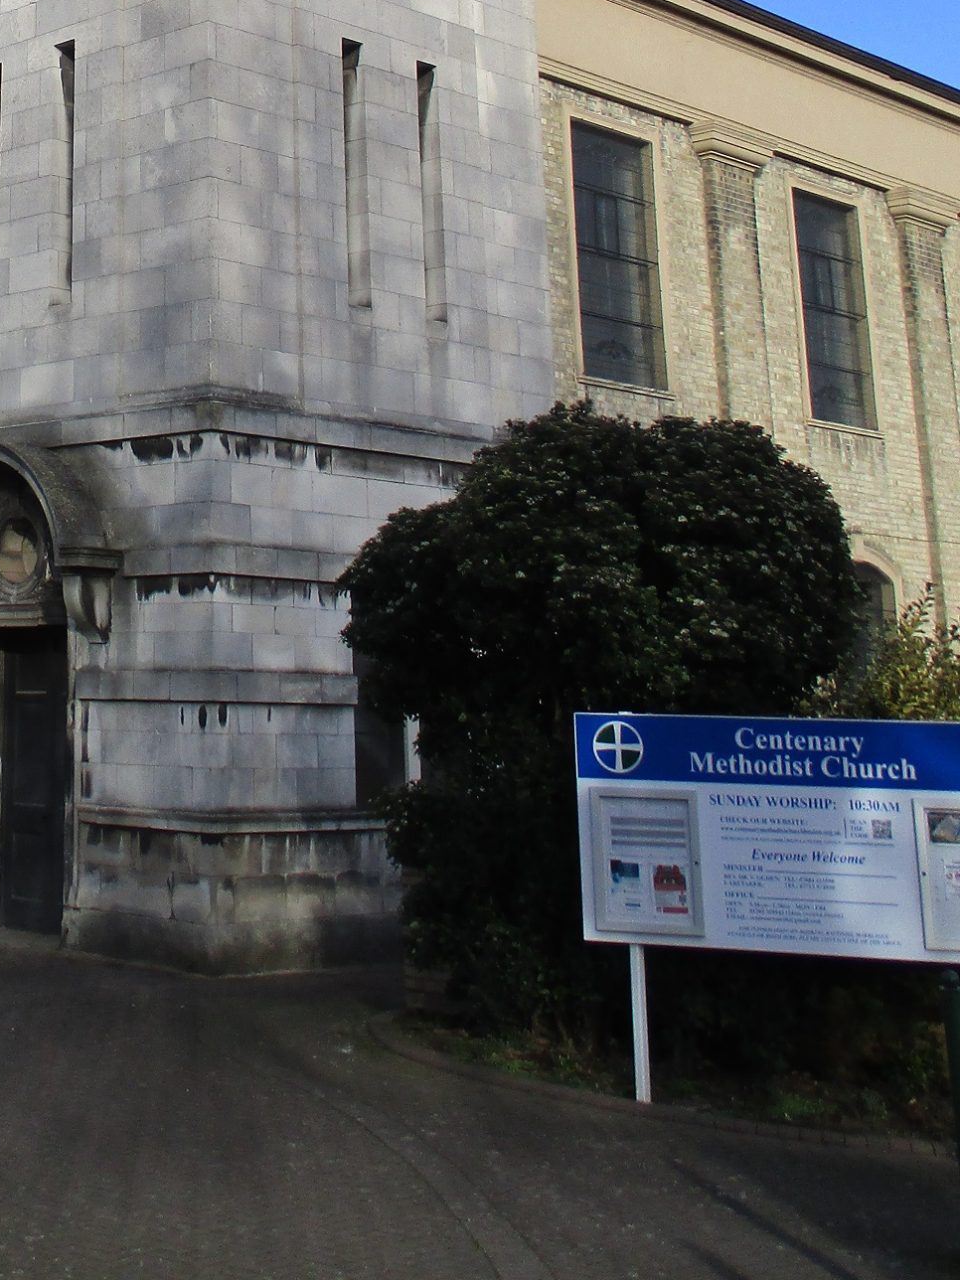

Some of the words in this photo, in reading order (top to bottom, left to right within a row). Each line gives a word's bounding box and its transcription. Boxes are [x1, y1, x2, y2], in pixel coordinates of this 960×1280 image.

[735, 727, 864, 757] Centenary
[689, 751, 813, 776] Methodist
[820, 756, 917, 780] Church
[708, 794, 761, 808] SUNDAY
[766, 796, 837, 810] WORSHIP:
[848, 799, 901, 812] 10:30AM
[751, 848, 805, 863] Everyone
[811, 851, 867, 865] Welcome
